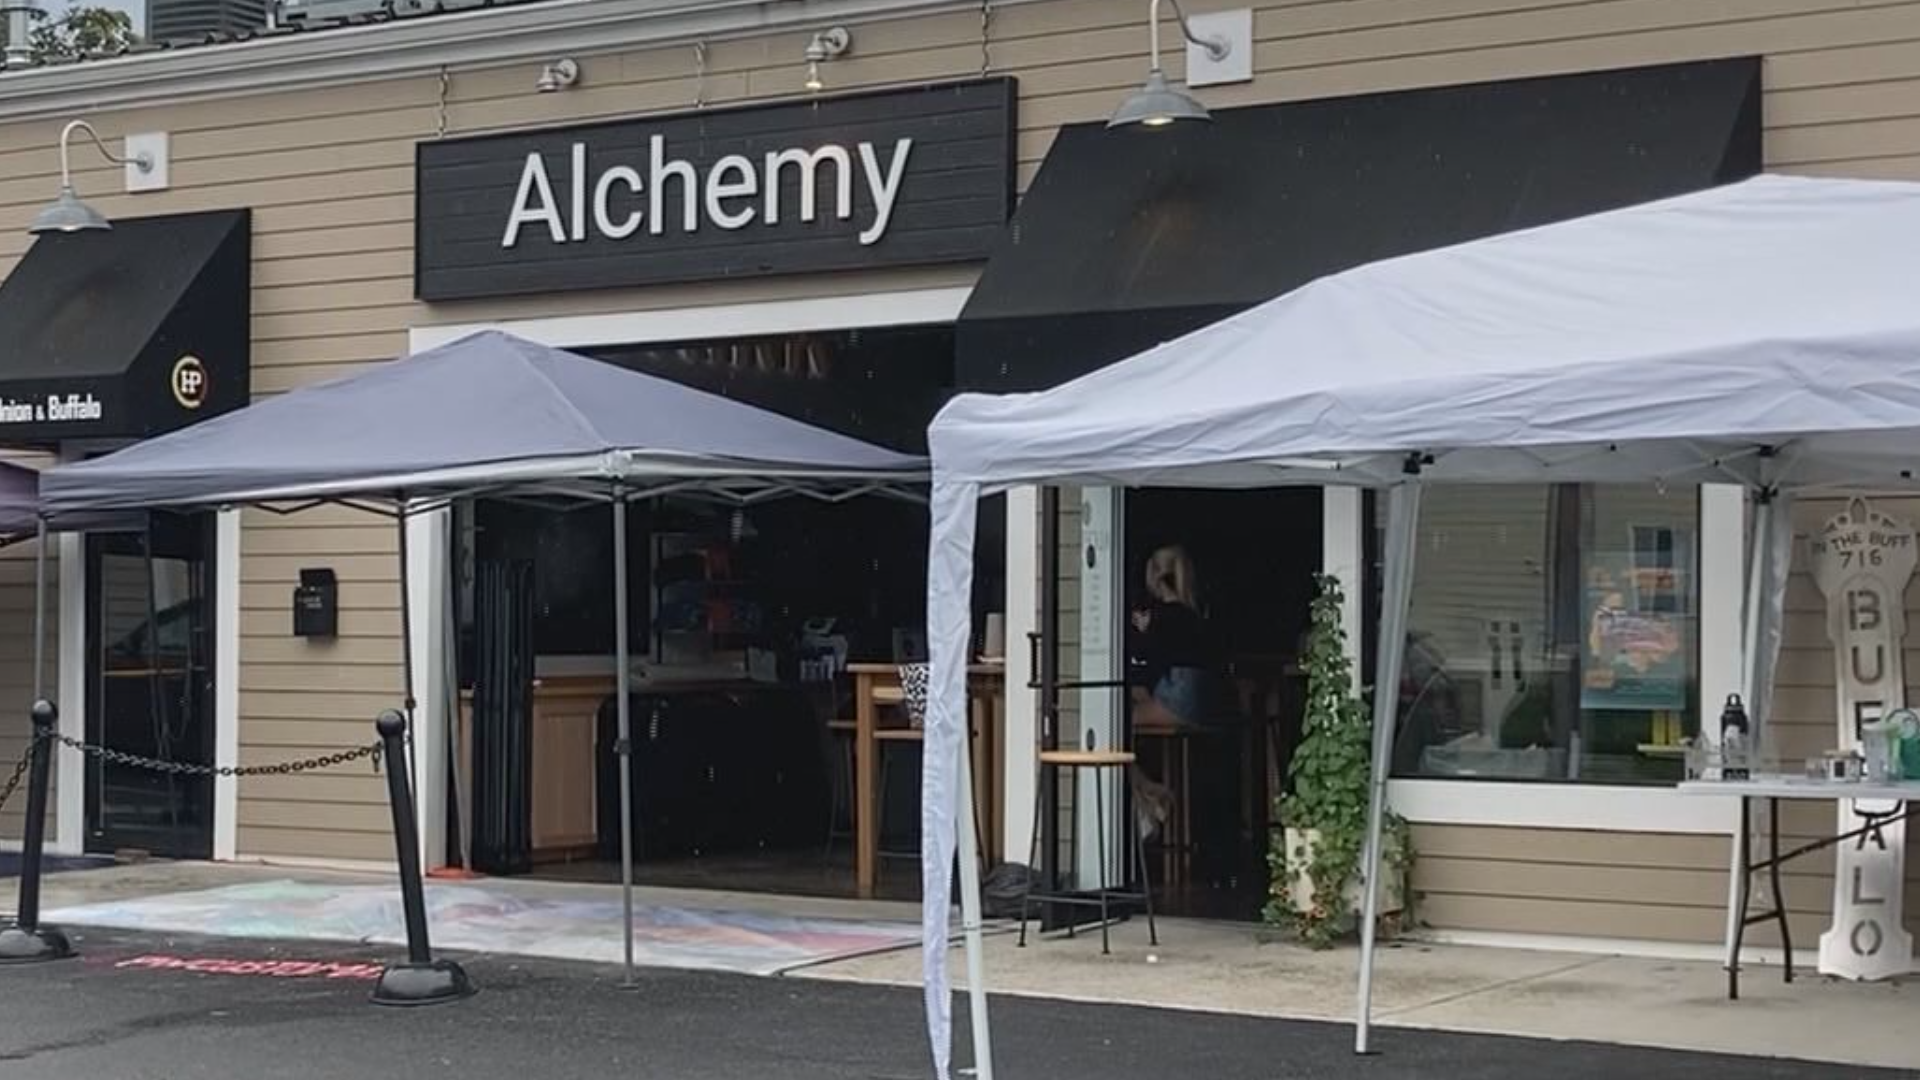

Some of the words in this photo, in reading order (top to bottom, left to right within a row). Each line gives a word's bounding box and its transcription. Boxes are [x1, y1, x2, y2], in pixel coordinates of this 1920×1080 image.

[502, 134, 913, 247] Alchemy
[35, 404, 46, 421] &
[48, 393, 101, 421] Buffalo
[1831, 531, 1862, 551] THE
[1869, 532, 1911, 549] BUFF
[1839, 549, 1883, 570] 716
[1848, 589, 1887, 957] BUFALO
